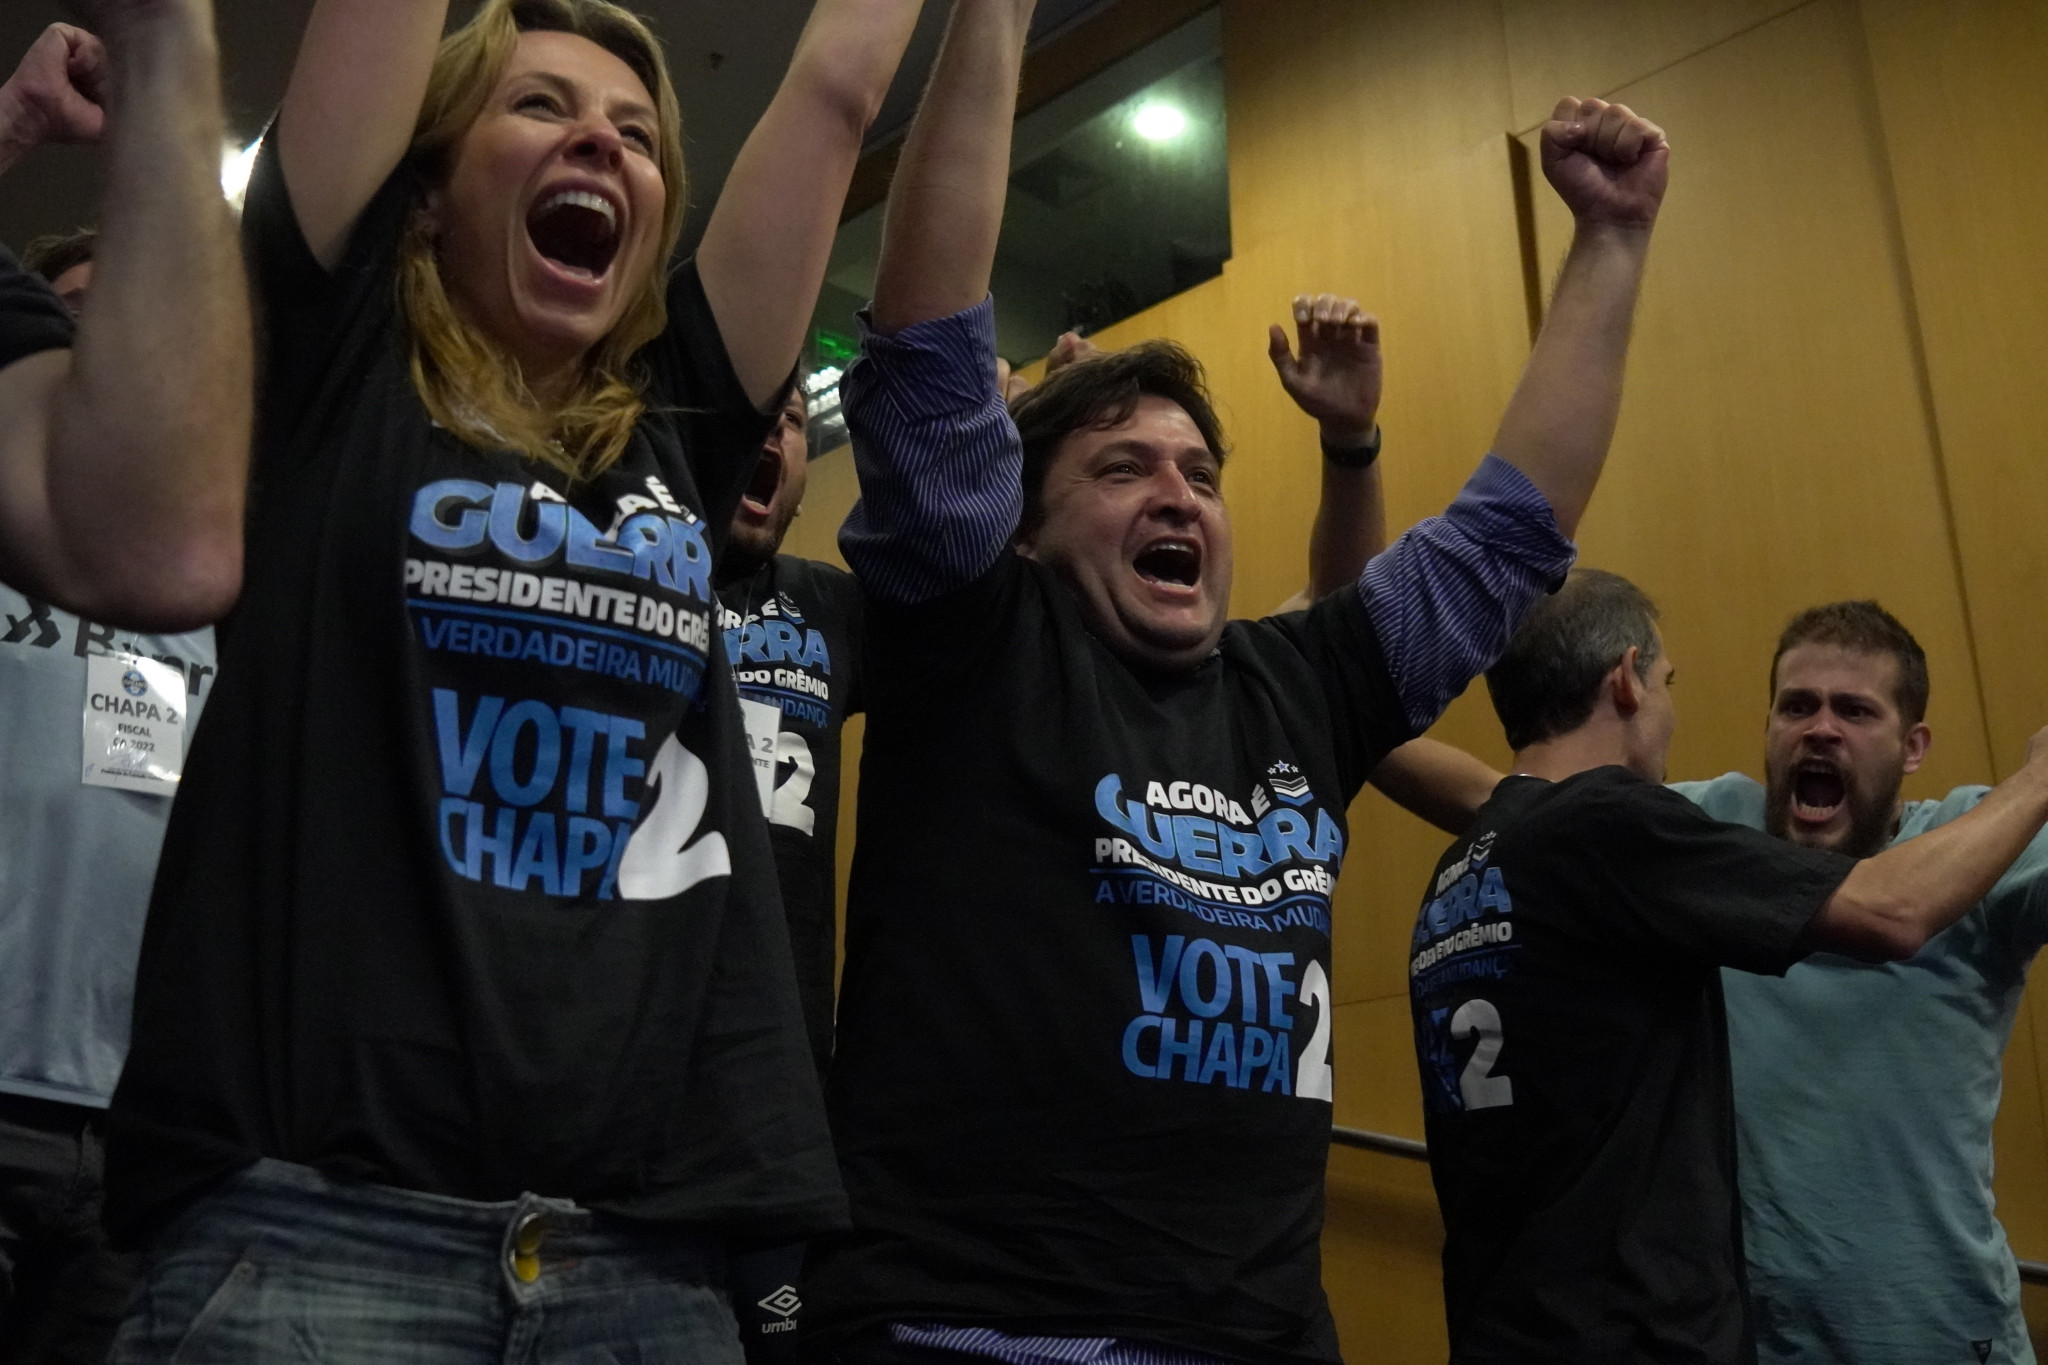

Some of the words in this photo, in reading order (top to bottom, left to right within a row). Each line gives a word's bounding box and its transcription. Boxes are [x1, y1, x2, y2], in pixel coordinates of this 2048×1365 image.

[408, 478, 713, 604] GURR
[404, 558, 636, 626] PRESIDENTE
[637, 596, 674, 637] DO
[676, 609, 710, 654] GRÊ
[420, 616, 641, 682] VERDADEIRA
[91, 693, 161, 722] CHAPA
[166, 708, 178, 725] 2
[739, 671, 771, 684] DO
[774, 668, 829, 700] GRÊMIO
[118, 722, 152, 738] FISCAL
[432, 687, 646, 821] VOTE
[761, 737, 773, 754] 2
[617, 730, 732, 900] 2
[1146, 780, 1253, 826] AGORA
[1251, 783, 1271, 818] É
[1095, 880, 1115, 904] A
[1117, 881, 1272, 933] VERDADEIRA
[1239, 878, 1282, 905] DO
[1455, 922, 1512, 952] GRÊMIO
[1131, 934, 1296, 1030] VOTE
[1121, 1015, 1292, 1096] CHAPA
[1295, 959, 1333, 1103] 2
[1450, 998, 1514, 1111] 2
